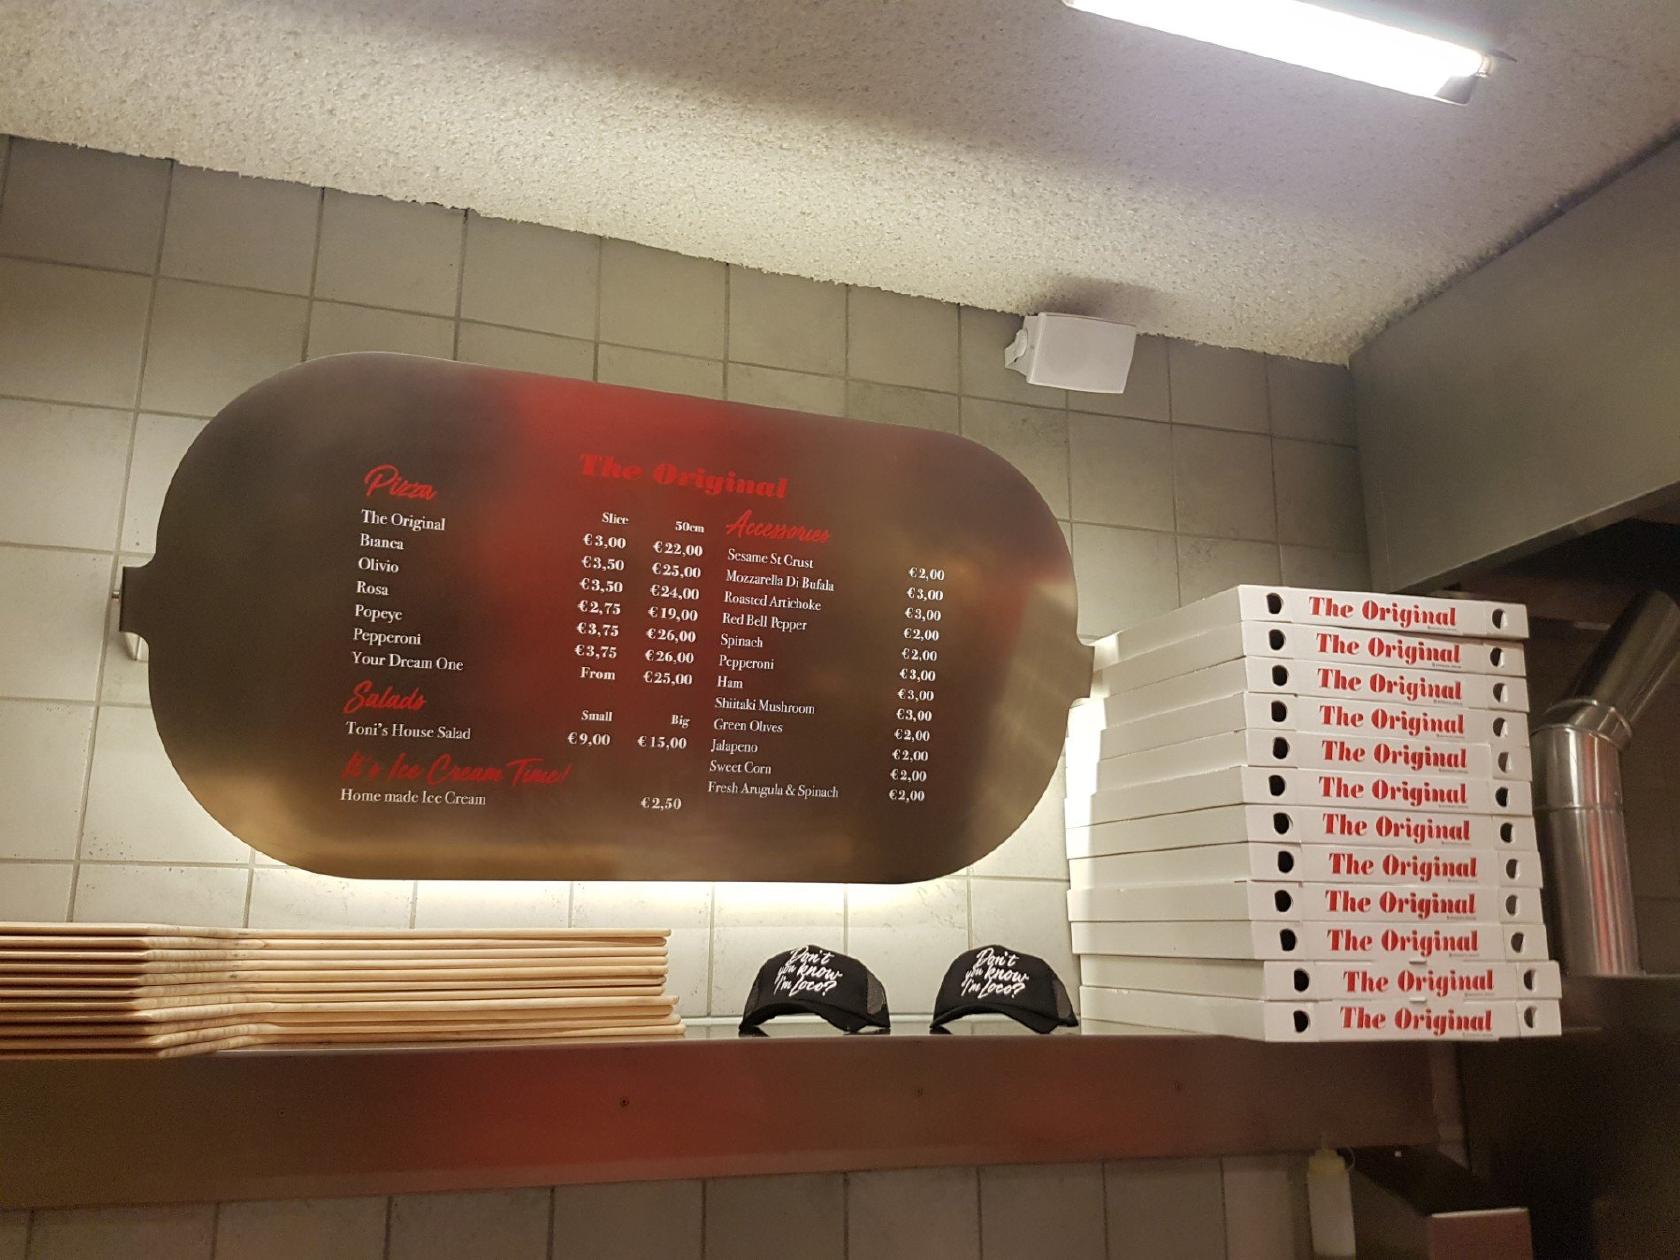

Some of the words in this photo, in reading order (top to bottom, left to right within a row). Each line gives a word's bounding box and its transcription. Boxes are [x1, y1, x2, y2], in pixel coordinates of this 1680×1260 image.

[363, 464, 438, 500] Pizza
[580, 453, 643, 480] The
[653, 463, 788, 498] Original
[361, 509, 388, 526] The
[391, 512, 446, 531] Original
[601, 512, 629, 525] Slice
[675, 521, 705, 534] 50cm
[726, 509, 832, 543] Accessories
[360, 534, 404, 551] Bianca
[358, 556, 399, 574] Olivio
[727, 548, 768, 564] Sesame
[770, 553, 782, 565] St
[783, 554, 813, 569] Crust
[356, 580, 389, 596] Rosa
[726, 569, 783, 587] Mozzarella
[786, 575, 799, 587] Di
[802, 577, 834, 592] Bufala
[724, 590, 768, 606] Roasted
[770, 596, 821, 611] Artichoke
[354, 604, 403, 623] Popeye
[722, 612, 744, 625] Red
[747, 614, 768, 628] Bell
[771, 617, 807, 632] Pepper
[1310, 596, 1355, 618] The
[1362, 601, 1456, 630] Original
[353, 628, 422, 647] Pepperoni
[720, 633, 763, 649] Spinach
[1316, 632, 1360, 656] The
[1367, 638, 1462, 665] Original
[351, 651, 386, 667] Your
[389, 654, 432, 670] Dream
[436, 657, 464, 671] One
[718, 654, 774, 671] Pepperoni
[580, 666, 616, 681] From
[717, 675, 743, 689] Ham
[1317, 668, 1363, 691] The
[1368, 673, 1463, 702] Original
[343, 679, 427, 713] Salads
[581, 710, 613, 722] Small
[758, 699, 815, 715] Mushroom
[671, 714, 690, 728] Big
[713, 718, 747, 732] Green
[749, 720, 783, 733] Olives
[1319, 704, 1365, 728] The
[1370, 709, 1465, 736] Original
[392, 723, 434, 738] House
[437, 725, 471, 740] Salad
[710, 738, 758, 755] Jalapeno
[1321, 739, 1366, 764] The
[1372, 743, 1467, 771] Original
[387, 752, 422, 782] Ice
[426, 753, 504, 786] Cream
[709, 759, 742, 774] Sweet
[744, 761, 772, 775] Corn
[340, 788, 381, 802] Home
[384, 791, 418, 804] made
[422, 791, 442, 804] Ice
[445, 791, 486, 806] Cream
[707, 781, 739, 794] Fresh
[741, 783, 783, 798] Arugula
[785, 784, 796, 796] &
[797, 784, 839, 799] Spinach
[1319, 775, 1364, 800] The
[1371, 780, 1468, 808] Original
[1321, 812, 1369, 836] The
[1375, 816, 1471, 844] Original
[1327, 851, 1376, 877] The
[1382, 855, 1478, 883] Original
[1324, 889, 1373, 913] The
[1379, 891, 1477, 921] Original
[1327, 928, 1375, 953] The
[1380, 928, 1480, 959] Original
[796, 960, 843, 980] know
[984, 963, 1030, 982] know
[1343, 969, 1391, 993] The
[1396, 968, 1495, 998] Original
[1338, 1006, 1388, 1031] The
[1393, 1008, 1493, 1038] Original
